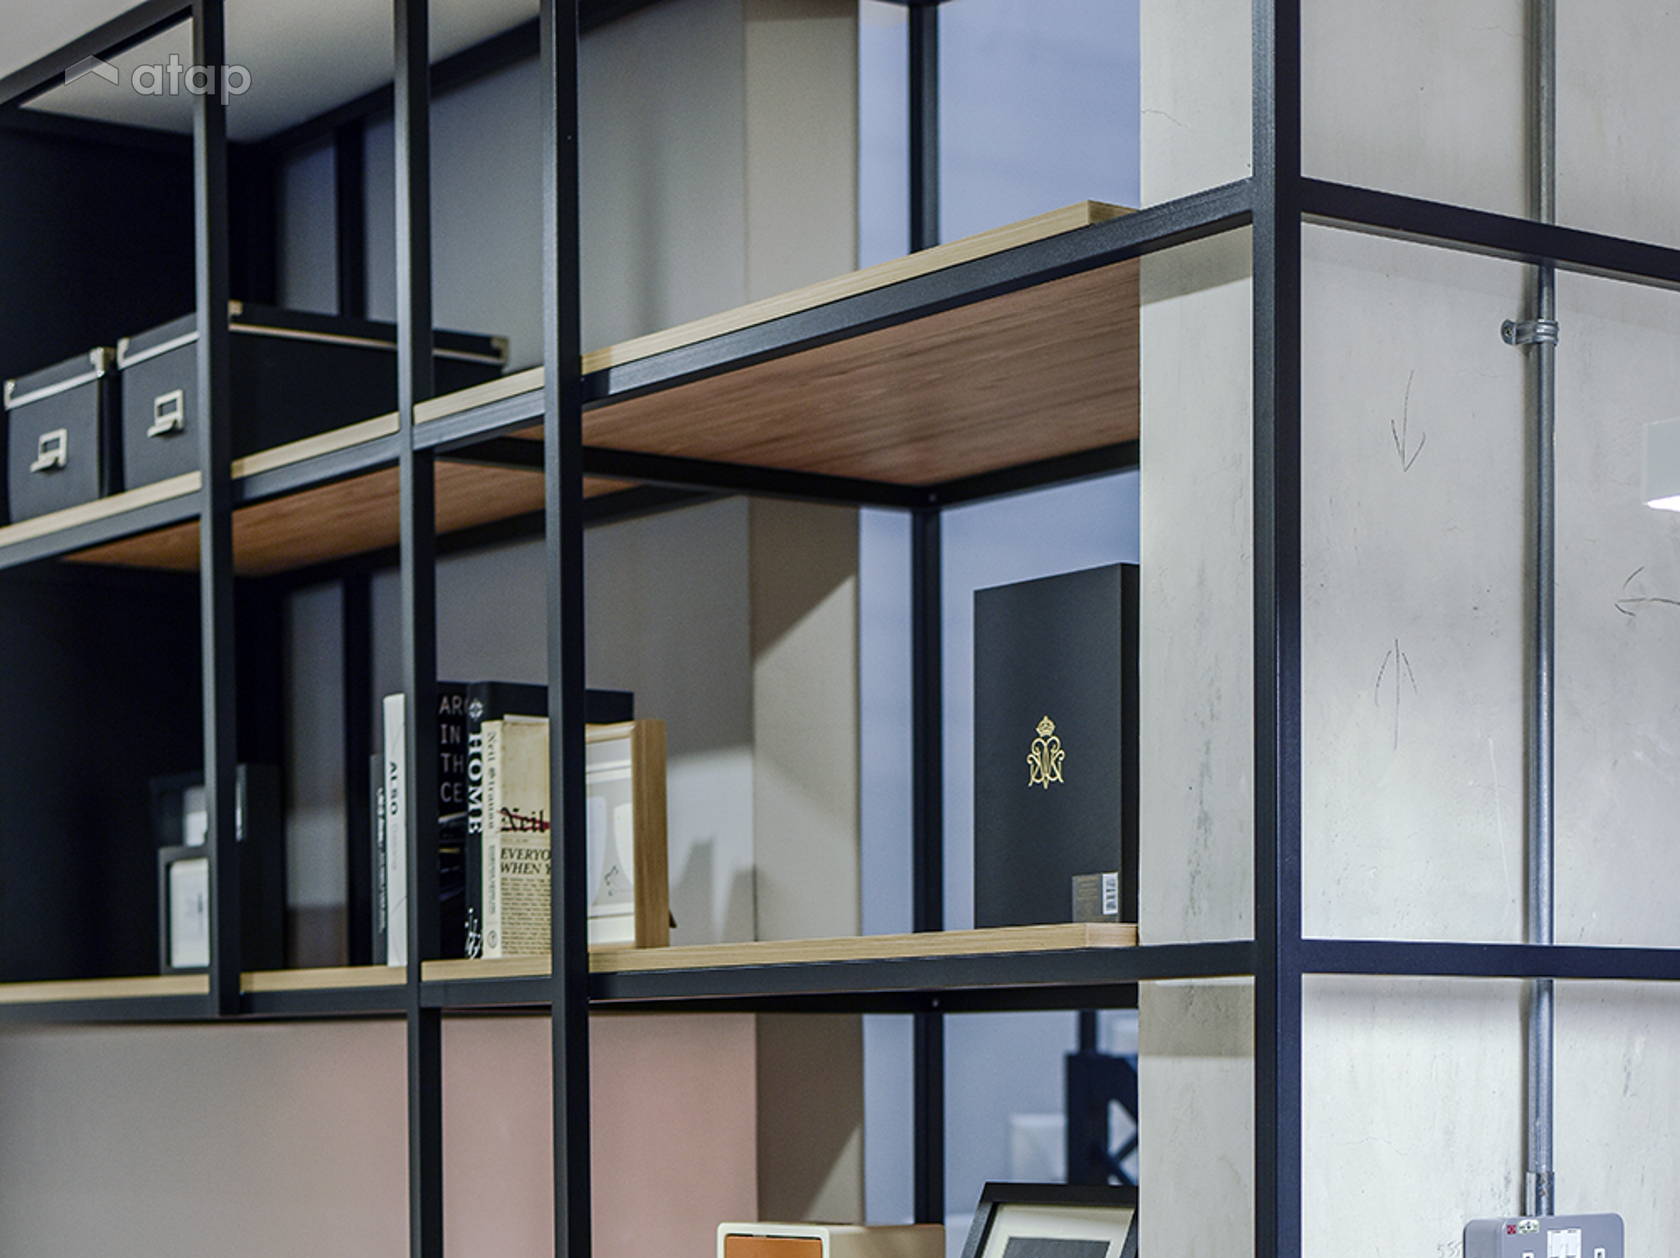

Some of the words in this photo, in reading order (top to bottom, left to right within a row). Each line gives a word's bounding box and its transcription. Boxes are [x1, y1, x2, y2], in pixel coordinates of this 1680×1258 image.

[440, 695, 469, 716] AR
[440, 723, 461, 745] IN
[390, 762, 399, 816] ALSO
[467, 732, 484, 835] HOME
[501, 862, 542, 875] WHEN
